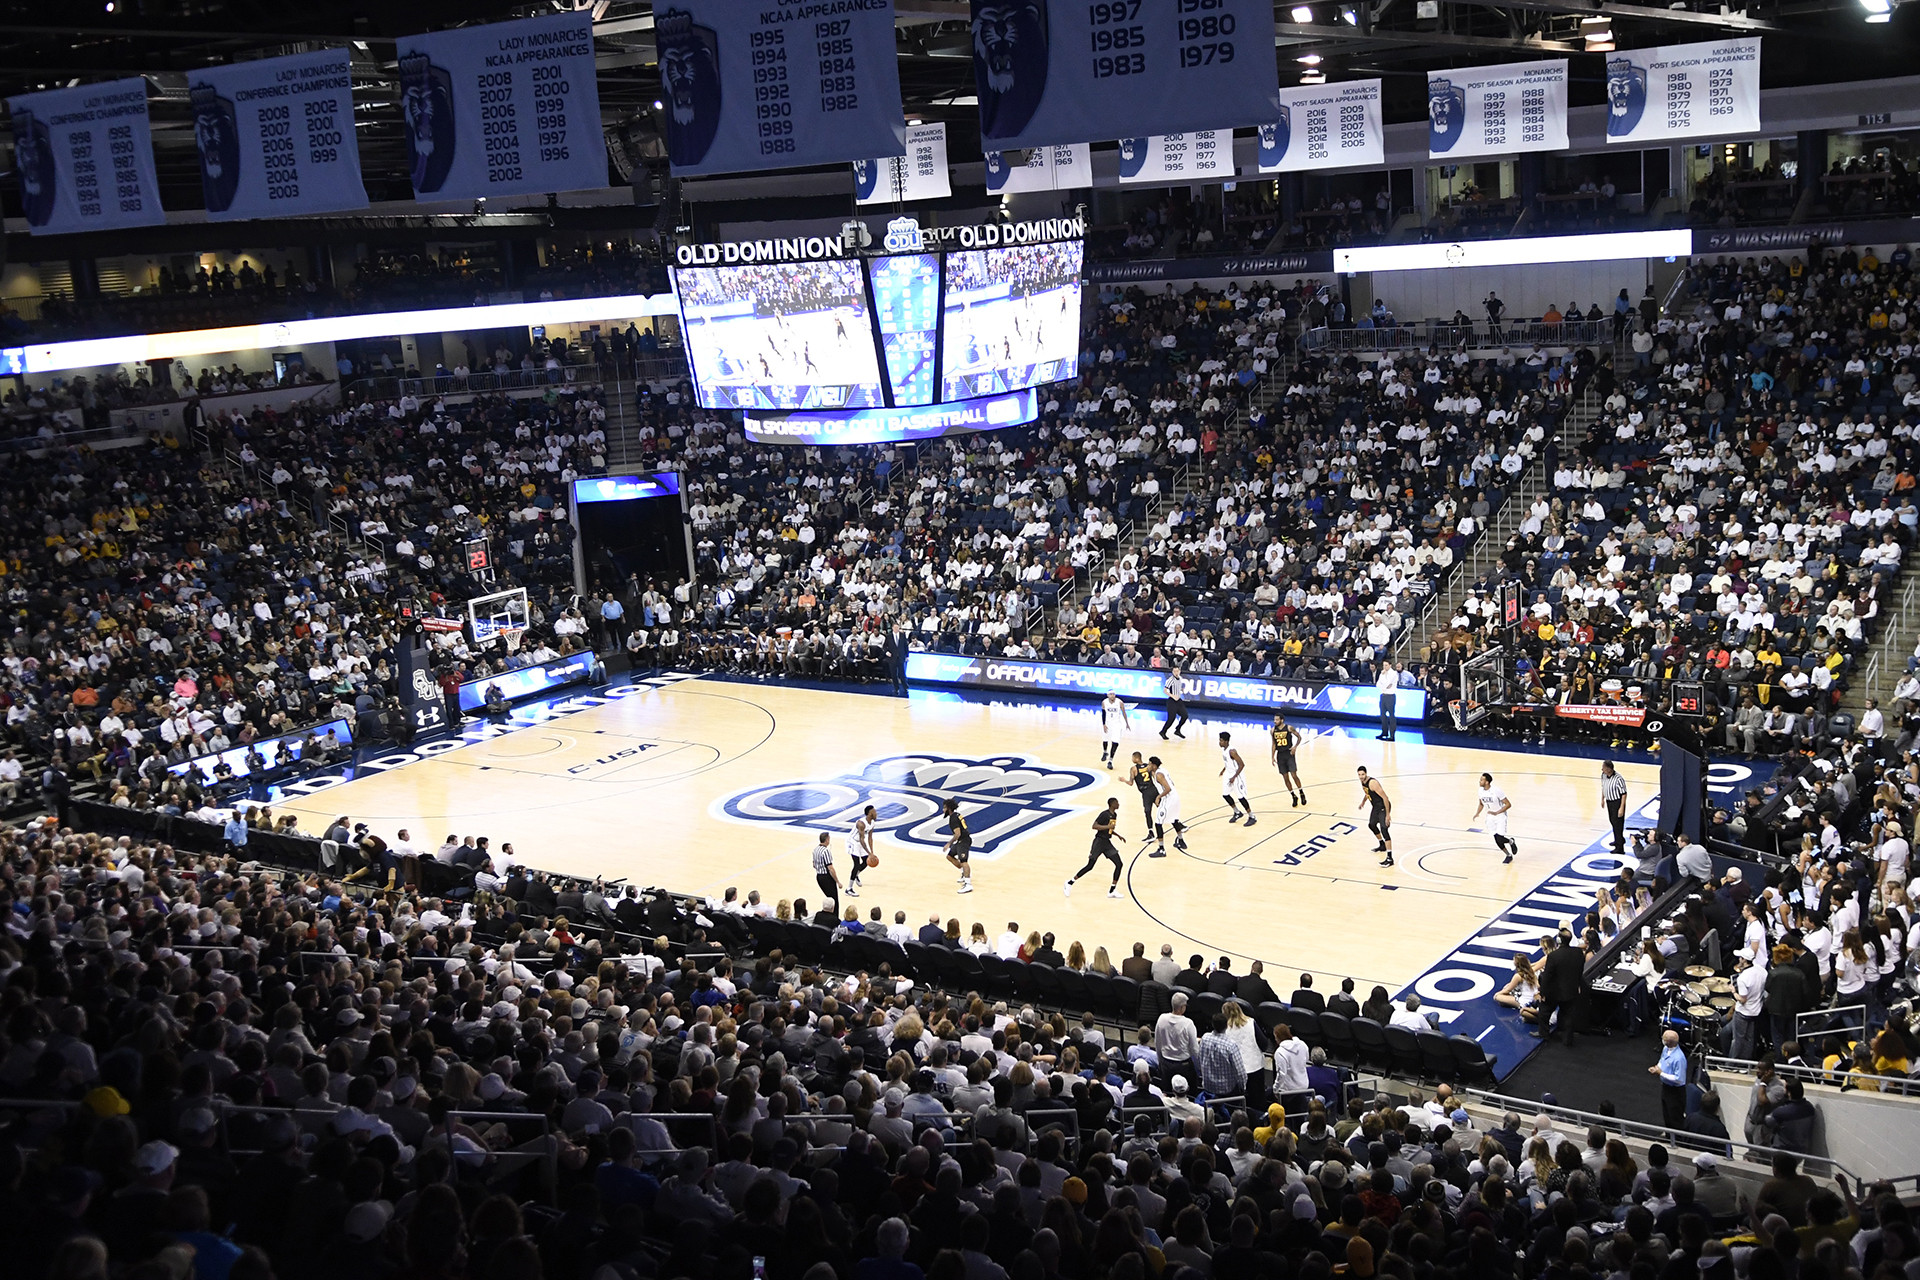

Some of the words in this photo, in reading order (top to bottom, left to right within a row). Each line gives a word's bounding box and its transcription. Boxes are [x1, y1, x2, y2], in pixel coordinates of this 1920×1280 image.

[760, 9, 793, 25] NCAA
[797, 0, 888, 20] APPEARANCES
[1089, 0, 1142, 26] 1997
[815, 19, 851, 38] 1987
[1178, 13, 1235, 40] 1980
[499, 36, 525, 51] LADY
[528, 28, 588, 47] MONARCHS
[750, 29, 785, 48] 1995
[1091, 25, 1145, 52] 1985
[485, 53, 513, 67] NCAA
[515, 43, 589, 63] APPEARANCES
[817, 38, 853, 57] 1985
[1180, 41, 1235, 68] 1979
[1712, 46, 1755, 56] MONARCHS
[752, 47, 787, 66] 1994
[1671, 59, 1700, 68] SEASON
[1702, 54, 1756, 64] APPEARANCES
[276, 70, 297, 82] LADY
[299, 62, 347, 79] MONARCHS
[532, 65, 562, 81] 2001
[819, 57, 856, 76] 1984
[1092, 53, 1145, 78] 1983
[1524, 67, 1563, 76] MONARCHS
[1709, 68, 1733, 78] 1974
[478, 71, 512, 88] 2008
[753, 65, 788, 84] 1993
[1487, 80, 1513, 88] SEASON
[1515, 75, 1563, 84] APPEARANCES
[1667, 73, 1687, 82] 1981
[235, 84, 289, 101] CONFERENCE
[291, 76, 349, 94] CHAMPIONS
[534, 81, 570, 98] 2000
[820, 75, 856, 94] 1983
[1667, 82, 1692, 91] 1980
[1709, 78, 1732, 87] 1973
[479, 88, 512, 104] 2007
[755, 83, 790, 102] 1992
[1343, 86, 1377, 95] MONARCHS
[1484, 92, 1505, 101] 1999
[1522, 88, 1545, 98] 1988
[1667, 91, 1690, 100] 1979
[1709, 88, 1728, 97] 1971
[304, 100, 338, 116] 2002
[535, 98, 564, 114] 1999
[821, 94, 858, 112] 1982
[1309, 98, 1334, 106] SEASON
[1335, 95, 1378, 103] APPEARANCES
[1484, 101, 1505, 110] 1997
[1522, 98, 1544, 107] 1986
[1668, 101, 1690, 110] 1977
[1709, 97, 1733, 106] 1970
[258, 106, 290, 121] 2008
[481, 103, 516, 120] 2006
[757, 102, 792, 120] 1990
[1306, 109, 1327, 117] 2016
[1340, 105, 1364, 114] 2009
[1484, 110, 1506, 119] 1995
[1522, 107, 1544, 116] 1985
[1668, 110, 1690, 119] 1976
[1710, 106, 1733, 115] 1969
[306, 116, 334, 132] 2001
[537, 114, 567, 130] 1998
[1307, 117, 1327, 126] 2015
[1340, 113, 1364, 123] 2008
[1484, 119, 1506, 127] 1994
[1522, 116, 1545, 124] 1984
[1668, 119, 1690, 128] 1975
[1866, 114, 1884, 125] 113
[260, 122, 290, 137] 2007
[483, 120, 517, 135] 2005
[758, 120, 793, 138] 1989
[1307, 126, 1327, 134] 2014
[1340, 122, 1364, 131] 2007
[1484, 128, 1506, 136] 1993
[1522, 125, 1544, 133] 1983
[308, 131, 342, 148] 2000
[539, 130, 567, 146] 1997
[1164, 133, 1184, 142] 2010
[1196, 131, 1215, 139] 1982
[1308, 134, 1327, 142] 2012
[1341, 131, 1365, 139] 2006
[1484, 136, 1506, 145] 1992
[1522, 133, 1544, 142] 1982
[262, 137, 294, 153] 2006
[485, 135, 520, 151] 2004
[760, 138, 796, 155] 1988
[1164, 143, 1187, 151] 2005
[1196, 141, 1216, 150] 1980
[1308, 143, 1324, 151] 2011
[1341, 139, 1365, 148] 2005
[264, 153, 295, 168] 2005
[310, 148, 337, 163] 1999
[487, 151, 520, 167] 2003
[540, 146, 570, 161] 1996
[1196, 151, 1215, 160] 1977
[1309, 151, 1328, 159] 2010
[1165, 163, 1184, 171] 1995
[1196, 161, 1216, 169] 1969
[266, 169, 298, 184] 2004
[488, 167, 523, 182] 2002
[268, 184, 299, 199] 2003
[960, 225, 999, 248] OLD
[1002, 218, 1084, 244] DOMINION
[885, 232, 922, 251] ODU
[1709, 234, 1730, 248] 52
[677, 243, 720, 265] OLD
[724, 236, 843, 263] DOMINION
[1222, 260, 1238, 273] 32
[1241, 257, 1308, 271] COPELAND
[763, 419, 822, 435] SPONSOR
[824, 419, 847, 434] OF
[849, 417, 884, 432] ODU
[888, 408, 985, 432] BASKETBALL
[470, 550, 486, 568] 23
[986, 663, 1048, 681] OFFICIAL
[1055, 669, 1134, 690] SPONSOR
[1138, 675, 1162, 692] OF
[1204, 680, 1318, 704] BASKETBALL
[1566, 707, 1595, 715] LIBERTY
[1681, 698, 1697, 710] 23
[567, 743, 659, 774] C-USA
[1141, 771, 1151, 782] 2
[723, 781, 1072, 854] ODU
